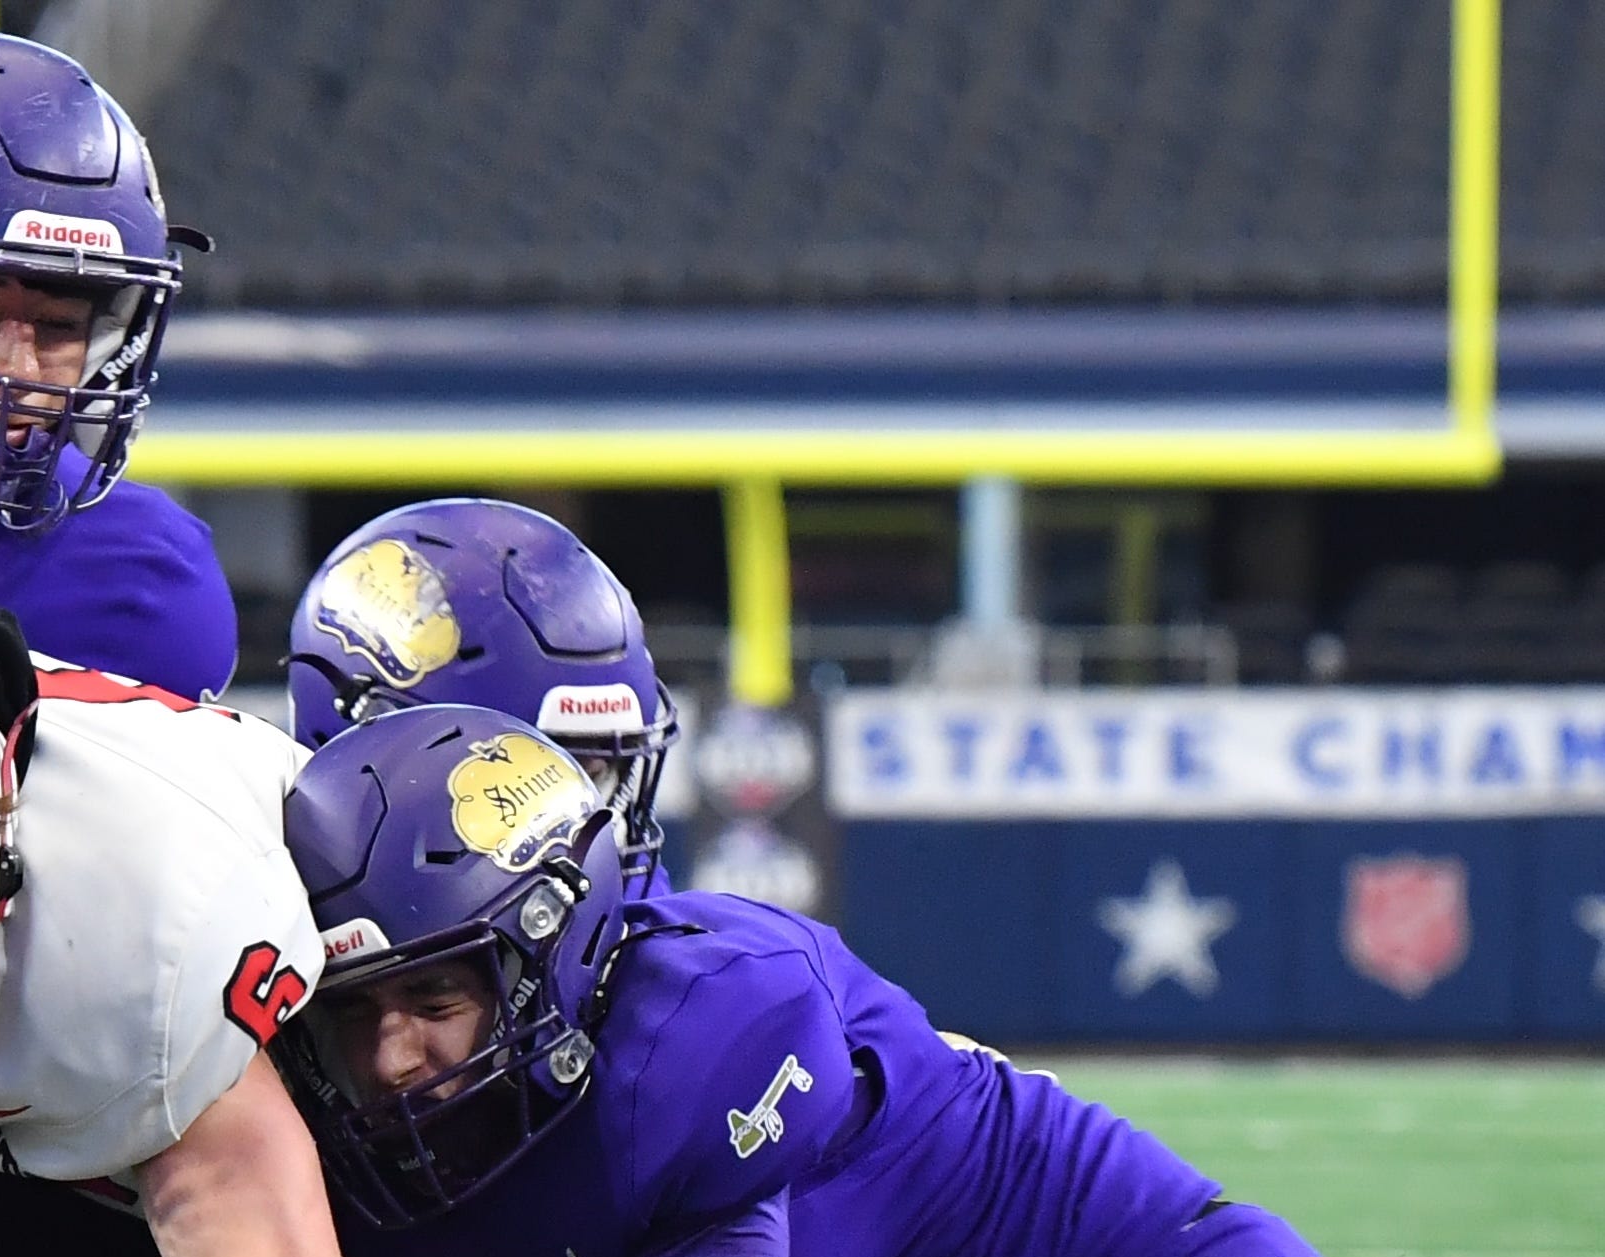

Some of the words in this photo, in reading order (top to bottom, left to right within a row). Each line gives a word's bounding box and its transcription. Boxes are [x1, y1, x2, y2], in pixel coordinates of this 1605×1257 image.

[25, 220, 111, 248] Riddell
[559, 695, 632, 715] Riddell
[860, 716, 1217, 783] STATE
[482, 764, 564, 829] Shiner
[223, 940, 308, 1049] 6
